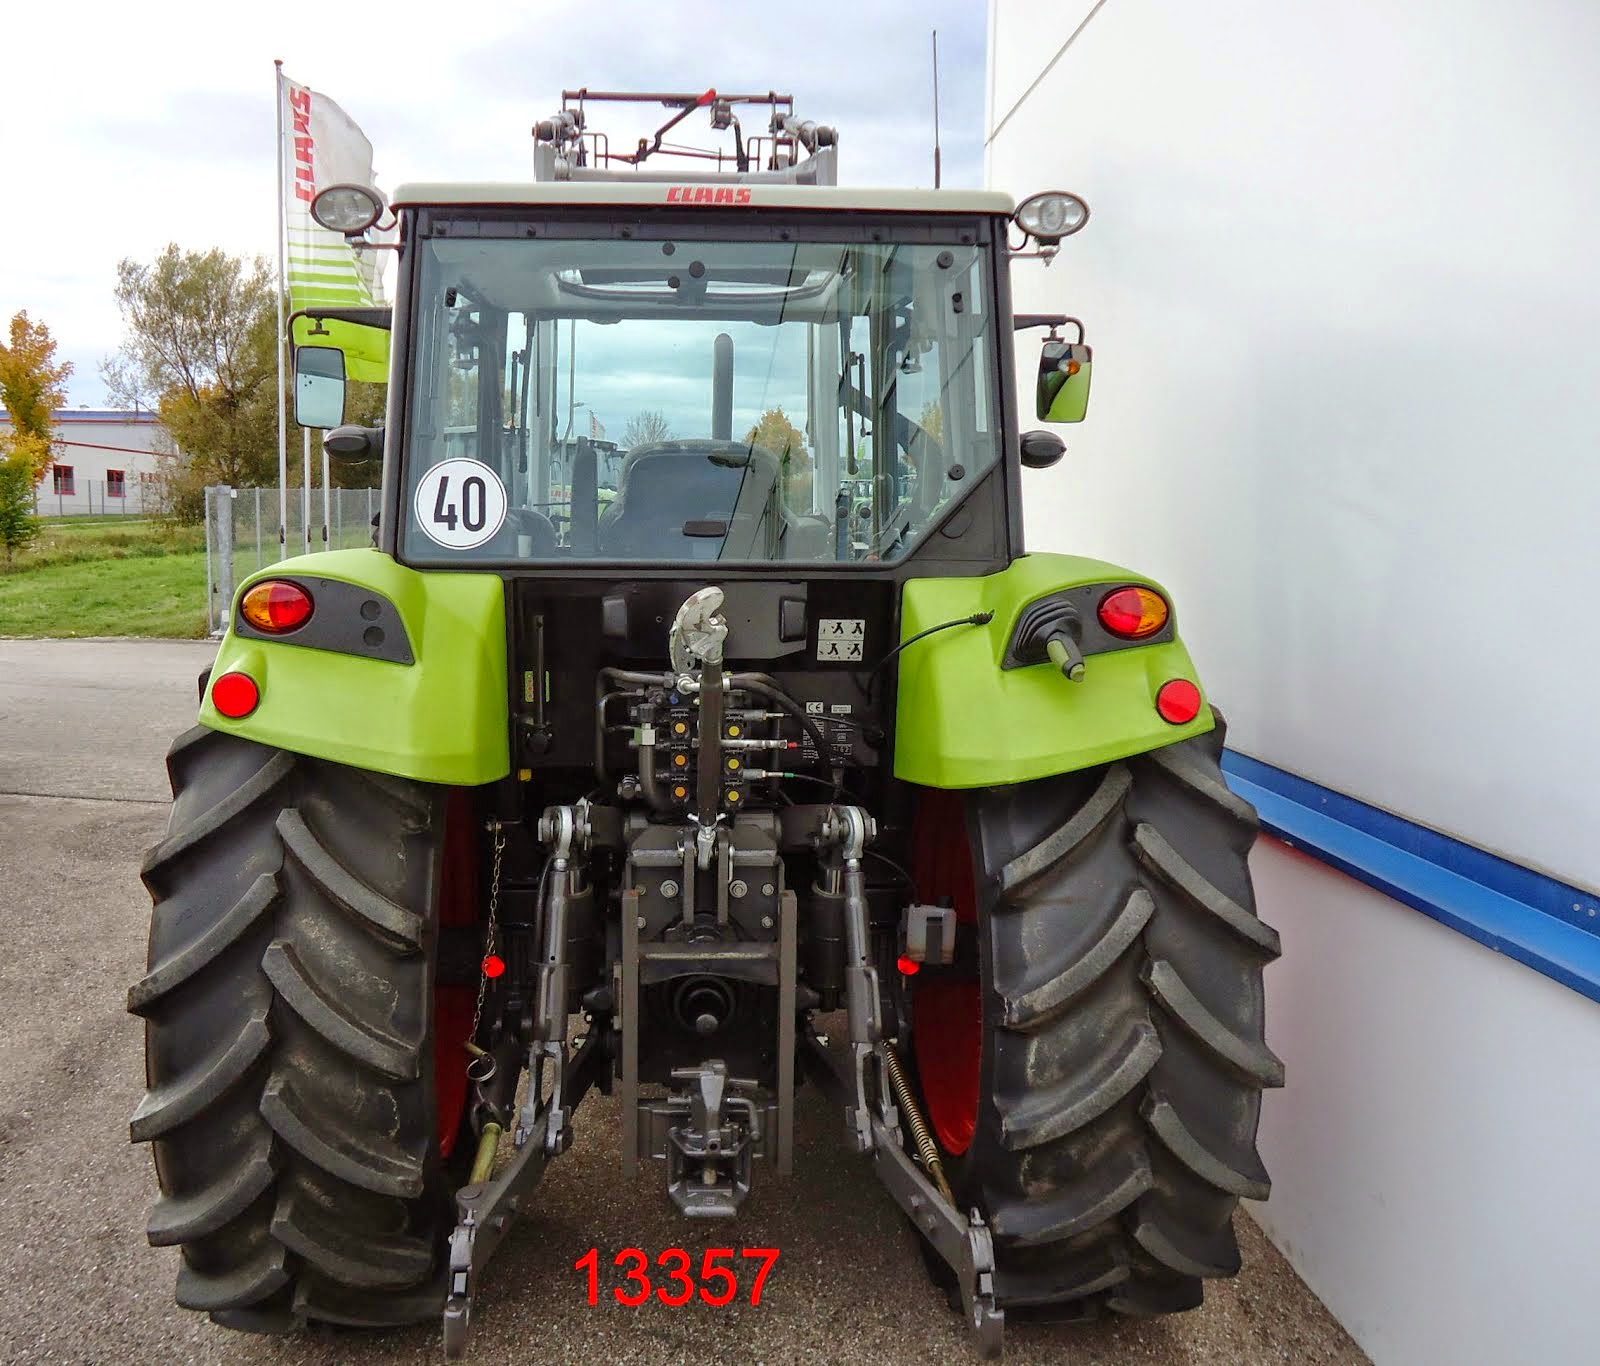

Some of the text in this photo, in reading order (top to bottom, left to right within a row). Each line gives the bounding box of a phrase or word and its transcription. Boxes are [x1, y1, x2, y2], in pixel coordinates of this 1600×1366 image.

[289, 86, 316, 203] CLAAS
[667, 186, 752, 203] CLAAS
[434, 476, 486, 532] 40
[808, 703, 822, 713] CE
